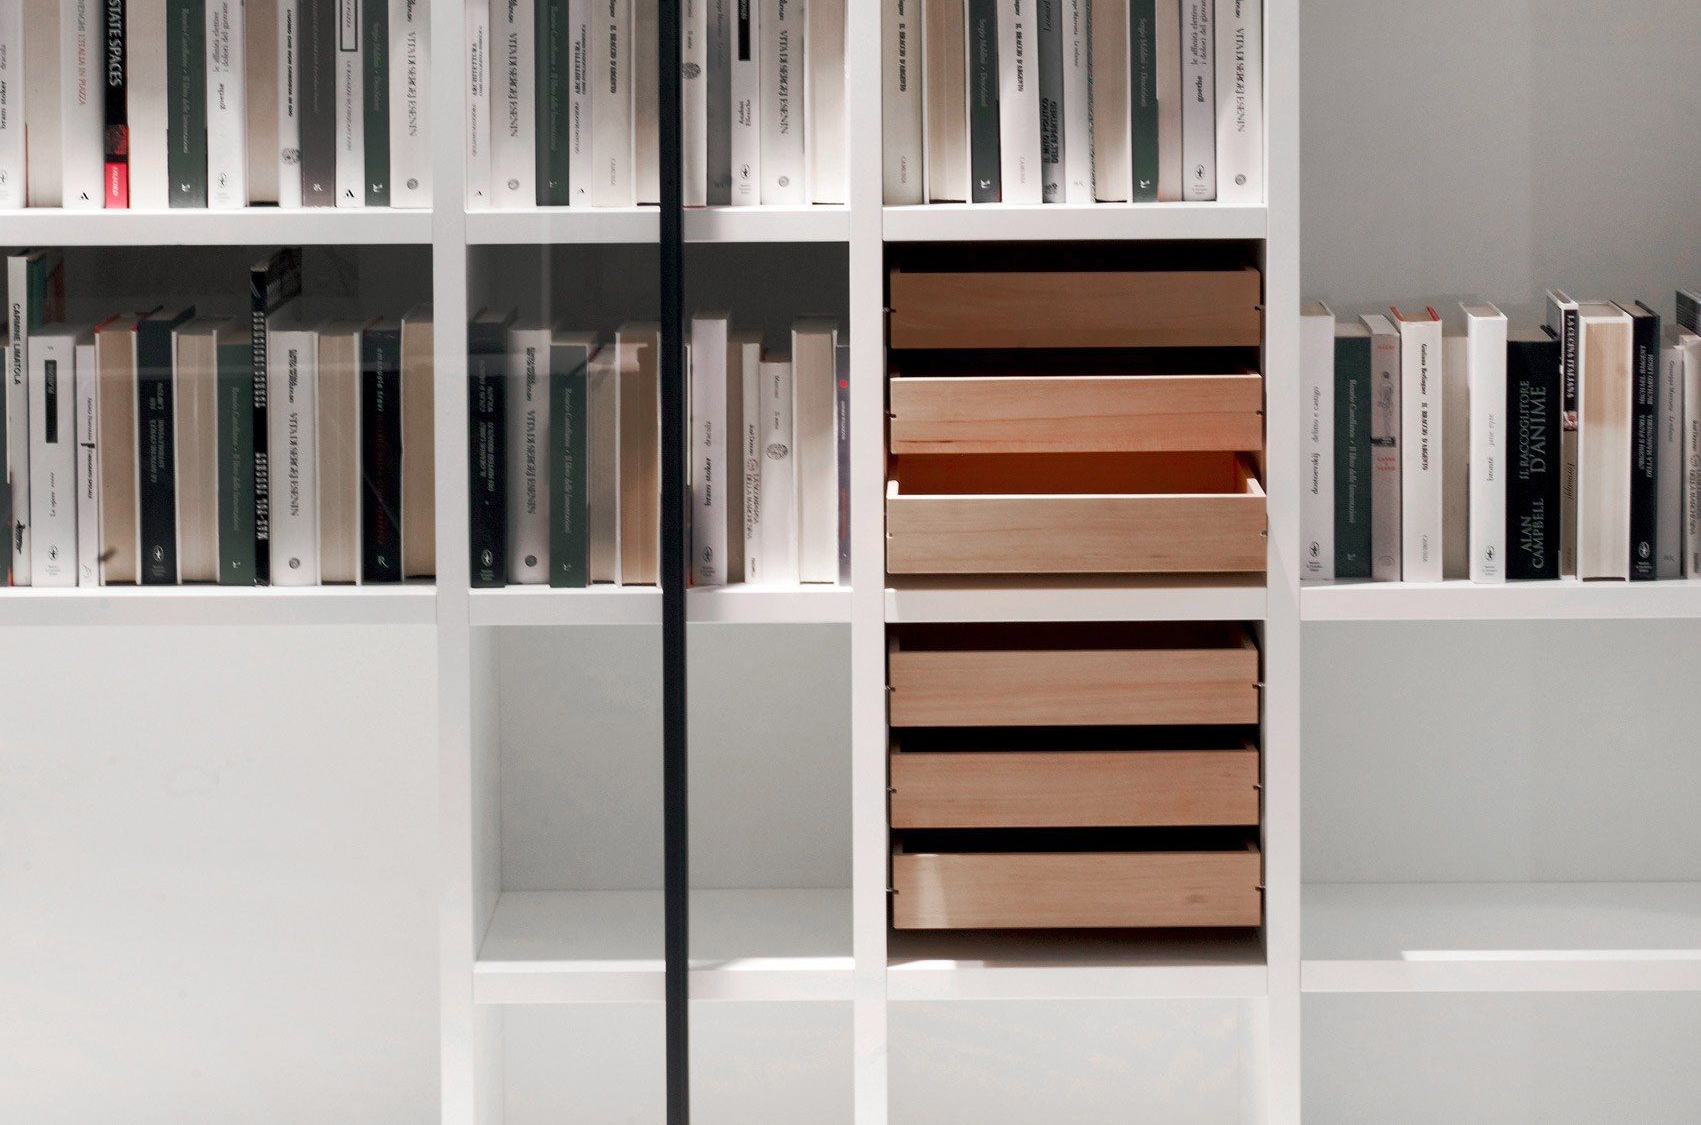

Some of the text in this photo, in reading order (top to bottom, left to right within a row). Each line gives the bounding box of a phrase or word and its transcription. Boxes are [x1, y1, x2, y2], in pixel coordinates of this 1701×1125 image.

[1043, 1, 1052, 33] Leonard
[1236, 27, 1244, 51] VITA
[108, 38, 122, 87] SPACES
[1196, 75, 1204, 103] goethe
[12, 303, 21, 385] CARMINE LIMATOLA
[1566, 314, 1575, 398] LA CUCINA ITALIANA
[1519, 380, 1530, 480] IL RACCOGLITORE
[1530, 386, 1547, 473] D'ANIME
[1566, 462, 1575, 500] Formaggi
[1646, 458, 1654, 478] DELLA
[1520, 515, 1532, 553] ALAN
[1532, 497, 1544, 569] CAMPBELL
